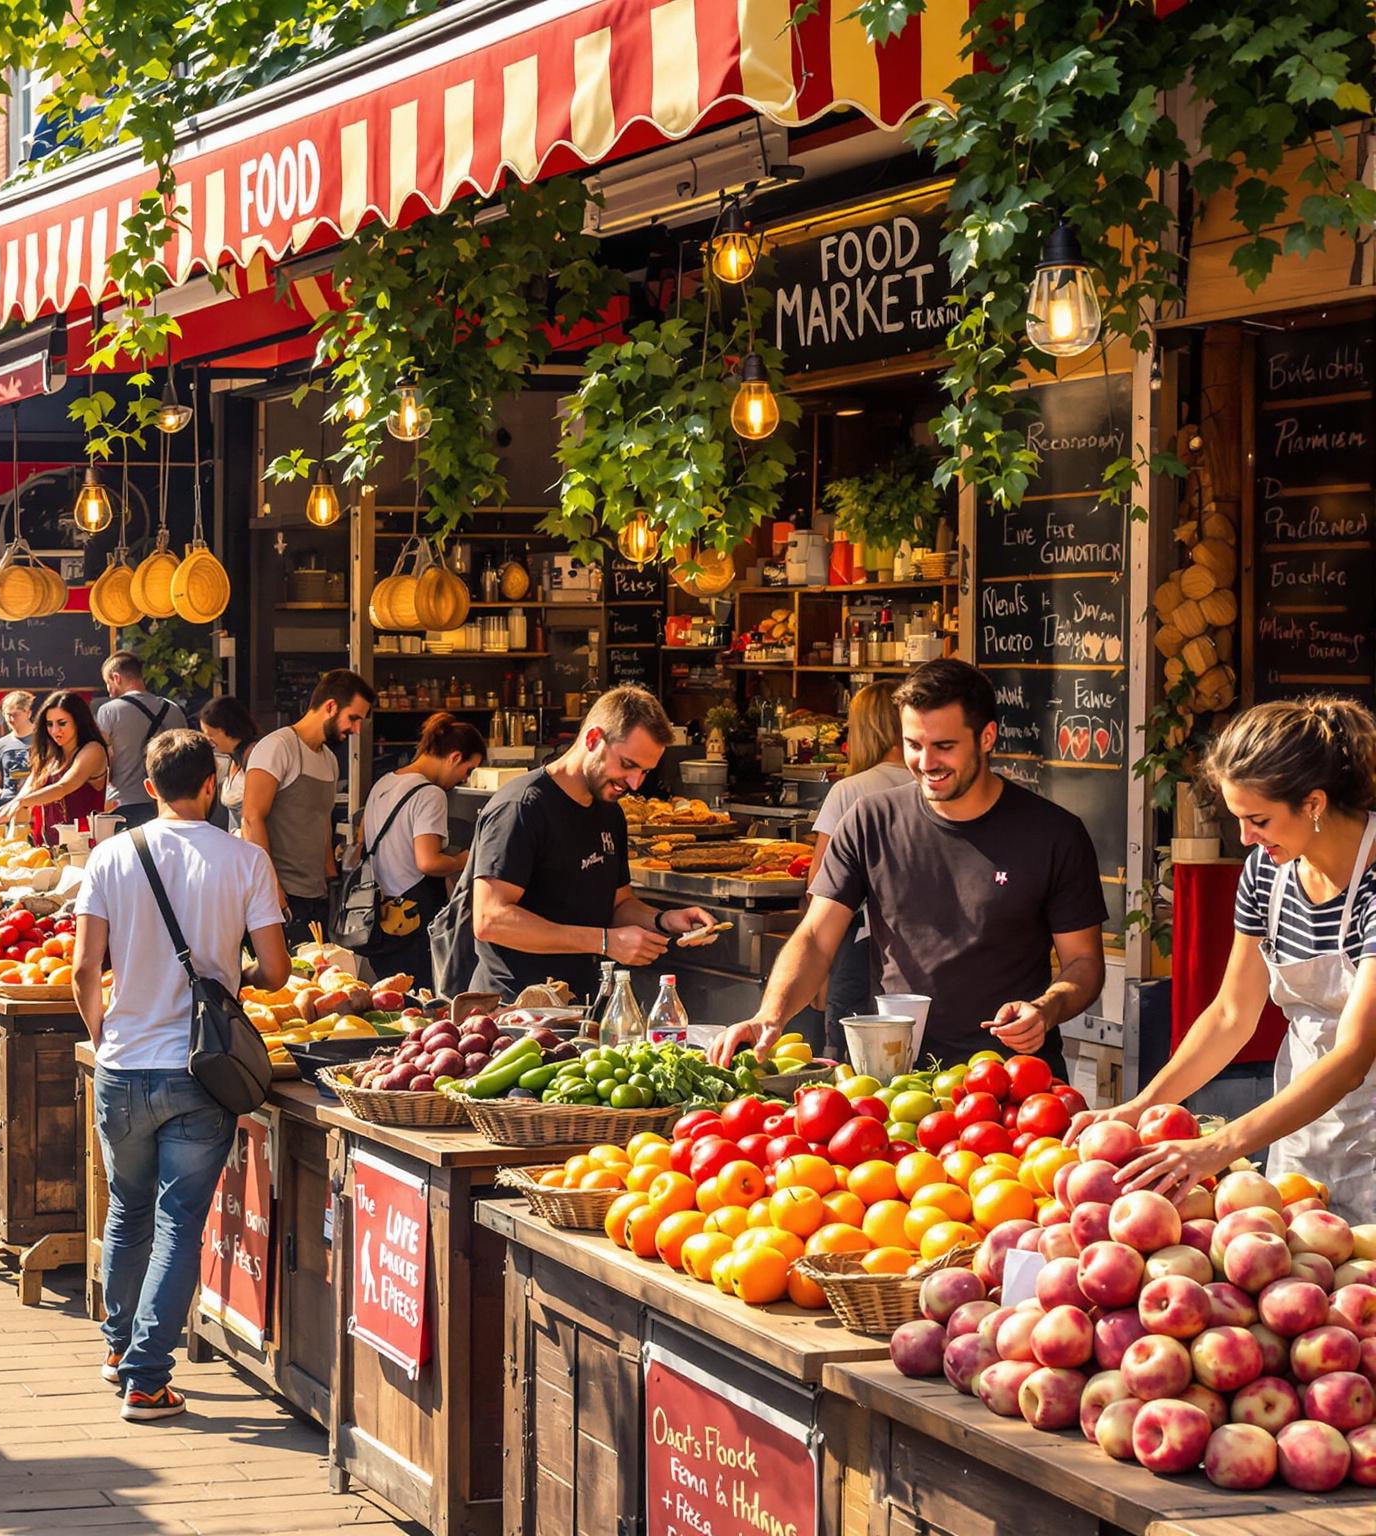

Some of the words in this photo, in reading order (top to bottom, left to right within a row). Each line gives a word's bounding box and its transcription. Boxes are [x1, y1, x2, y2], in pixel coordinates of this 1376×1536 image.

[239, 139, 321, 233] FOOD
[820, 217, 920, 282] FOOD
[776, 264, 934, 350] MARKET
[356, 1184, 376, 1217] The
